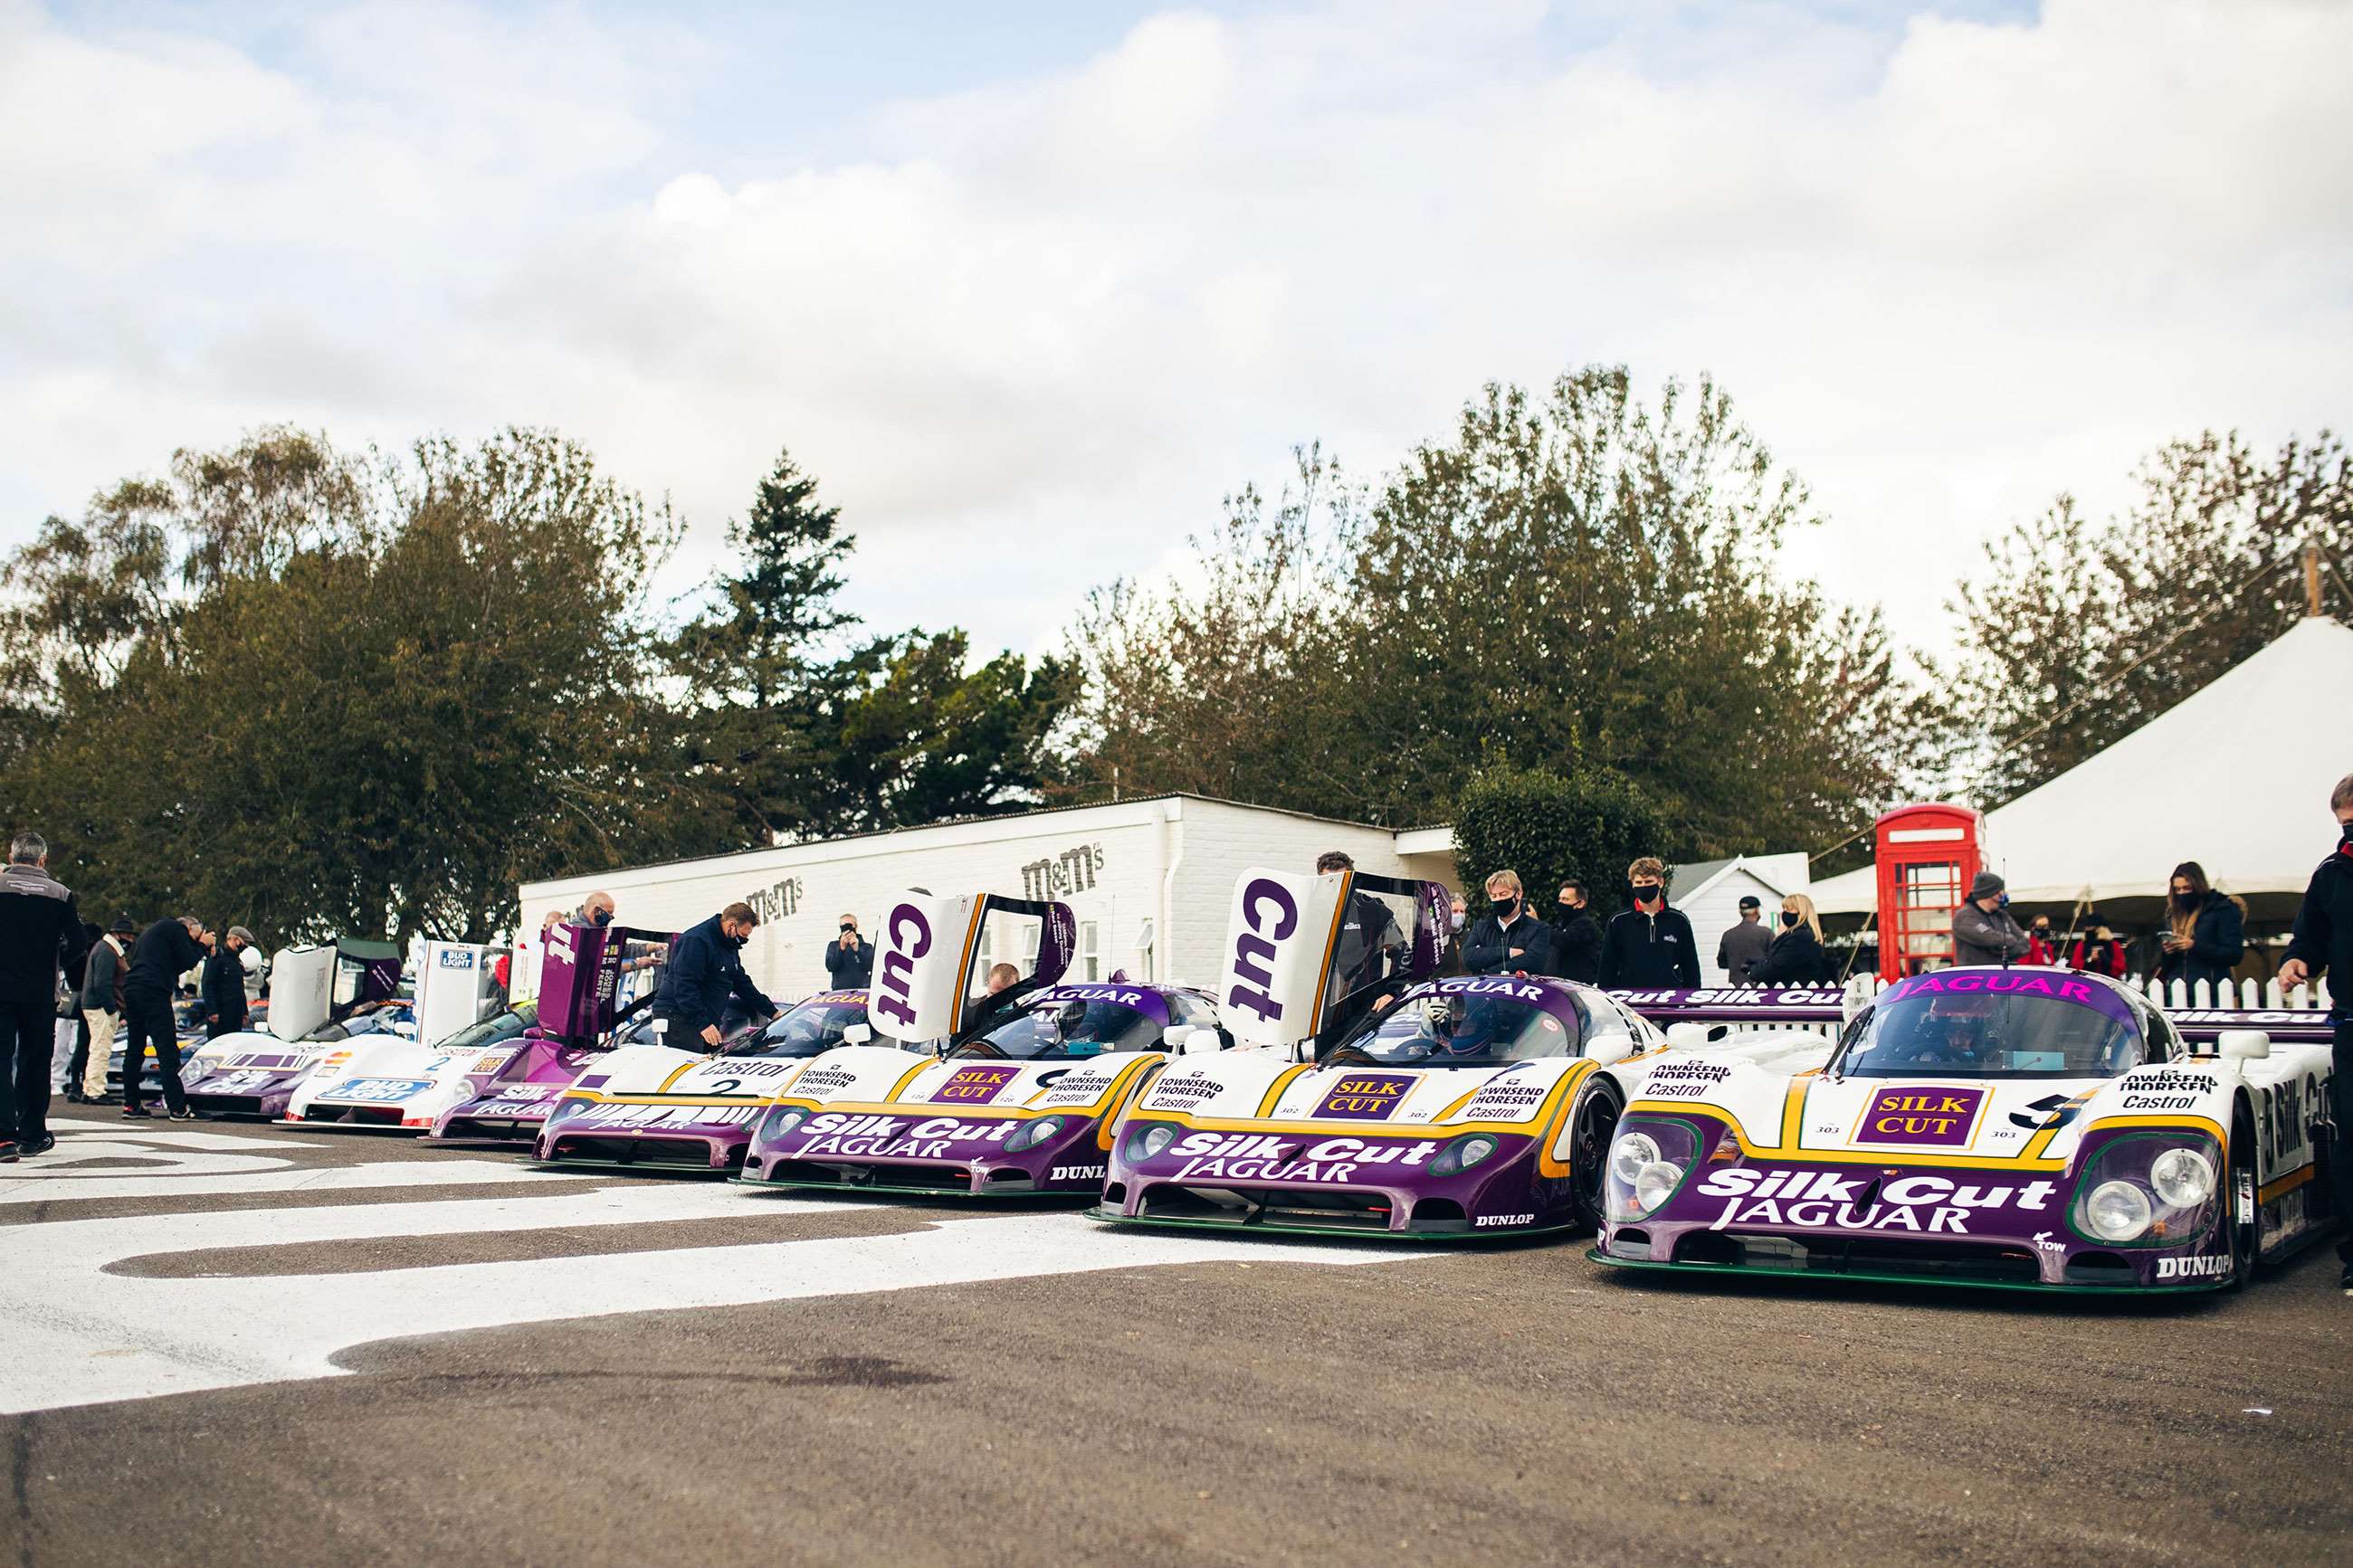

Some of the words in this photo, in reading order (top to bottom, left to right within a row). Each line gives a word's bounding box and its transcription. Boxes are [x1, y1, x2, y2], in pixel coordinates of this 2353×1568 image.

[447, 951, 468, 959] BUD
[1229, 879, 1298, 1022] Cut
[443, 958, 472, 968] LIGHT
[878, 904, 931, 1026] Cut
[1398, 982, 1544, 1002] JAGUAR
[1884, 975, 2091, 1003] JAGUAR
[1685, 990, 1768, 1004] Silk
[1777, 990, 1847, 1004] Cu
[2248, 1012, 2329, 1023] Cu
[426, 1057, 451, 1071] 2
[699, 1060, 794, 1078] Castrol
[1656, 1064, 1731, 1078] OWNSEND
[798, 1077, 850, 1088] THORESEN
[803, 1069, 857, 1082] TOWNSEND
[951, 1070, 1010, 1086] SILK
[1060, 1077, 1113, 1085] OWNSEND
[2126, 1074, 2219, 1087] OWNSEND
[353, 1079, 414, 1091] BUD
[794, 1086, 834, 1097] Castrol
[942, 1085, 993, 1098] CUT
[1158, 1078, 1224, 1093] TOWNSEND
[1335, 1080, 1405, 1097] SILK
[1478, 1087, 1545, 1097] OWNSEND
[1645, 1083, 1709, 1098] Castrol
[496, 1086, 552, 1100] Silk
[1046, 1093, 1091, 1102] Castrol
[1155, 1086, 1217, 1100] THORESEN
[1151, 1097, 1200, 1109] Castrol
[1328, 1097, 1388, 1113] CUT
[1877, 1096, 1972, 1114] SILK
[2122, 1095, 2197, 1110] Castrol
[1466, 1107, 1521, 1119] Castrol
[2008, 1094, 2091, 1131] 5
[2273, 1079, 2302, 1159] Silk
[589, 1118, 692, 1130] JAGUAR
[800, 1114, 908, 1137] Silk
[910, 1117, 1019, 1141] Cut
[1815, 1126, 1840, 1135] 303
[1875, 1117, 1958, 1136] CUT
[1991, 1131, 2016, 1139] 303
[790, 1135, 952, 1160] JAGUAR
[1169, 1133, 1297, 1158] Silk
[1307, 1138, 1437, 1165] Cut
[971, 1164, 991, 1174] TOW
[1050, 1165, 1106, 1181] DUNL
[1168, 1157, 1358, 1183] JAGUAR
[1697, 1168, 1867, 1202] Silk
[1881, 1176, 2057, 1211] Cut
[1474, 1213, 1535, 1227] DUNLOP
[1709, 1197, 1971, 1233] JAGUAR
[2036, 1240, 2067, 1253] TOW
[2156, 1254, 2232, 1278] DUNLOP
